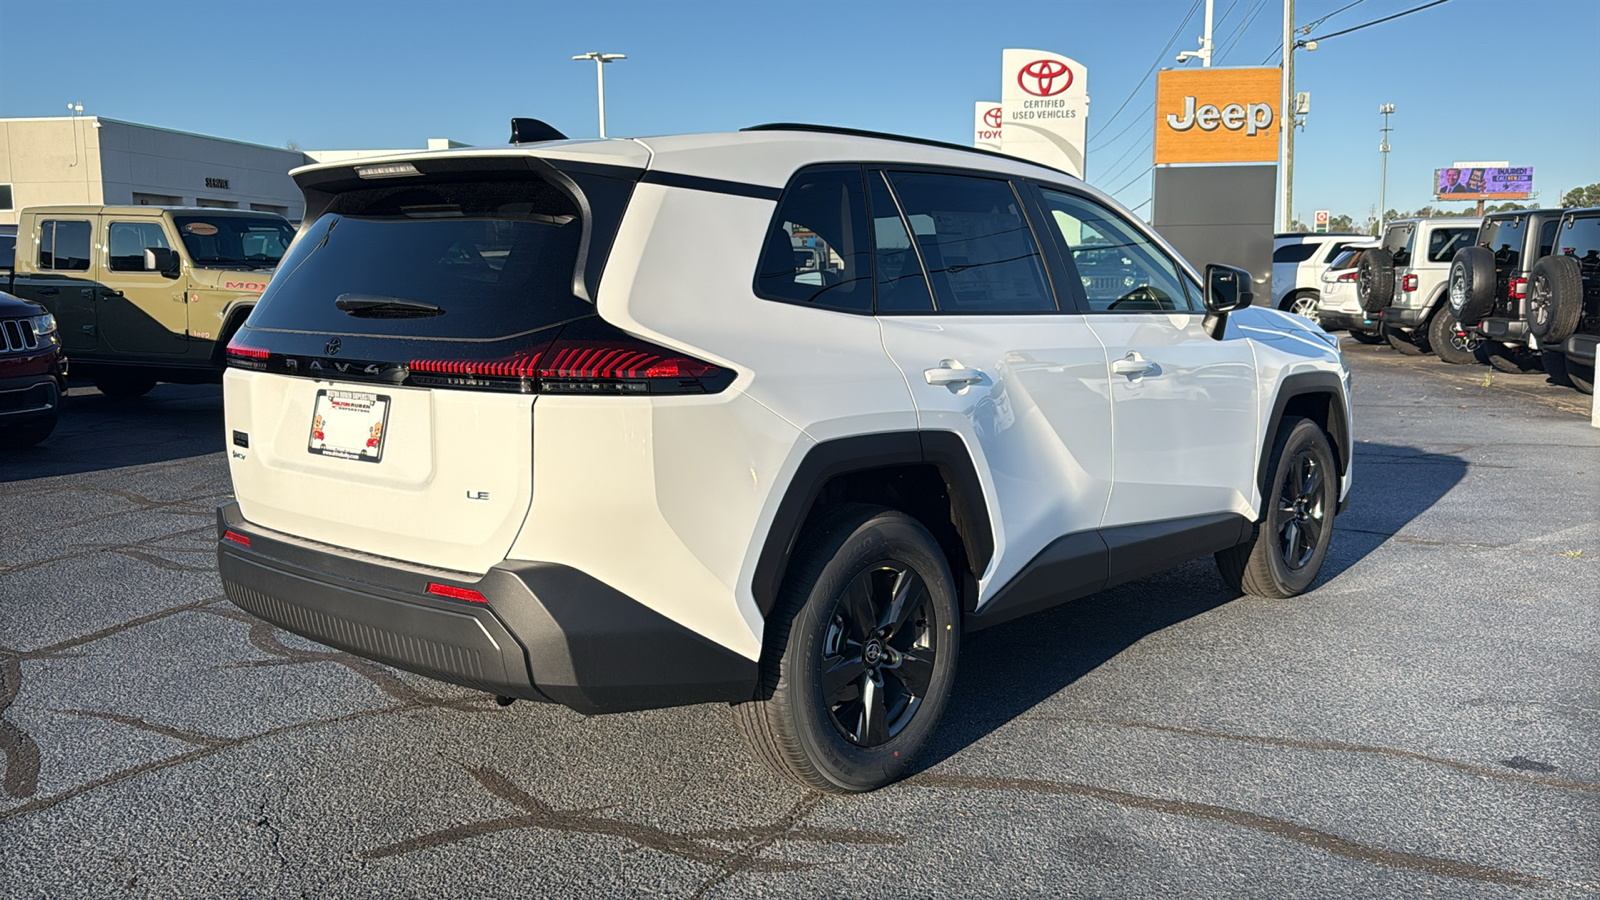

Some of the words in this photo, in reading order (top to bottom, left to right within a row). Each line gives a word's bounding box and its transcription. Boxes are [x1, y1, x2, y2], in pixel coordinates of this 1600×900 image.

[1023, 99, 1065, 109] CERTIFIED
[1012, 111, 1035, 120] USED
[1037, 109, 1076, 119] VEHICLES
[1166, 96, 1274, 136] Jeep
[205, 177, 230, 190] SERVICE
[193, 330, 210, 339] Jeep
[286, 358, 380, 375] RAV4
[467, 490, 490, 500] LE
